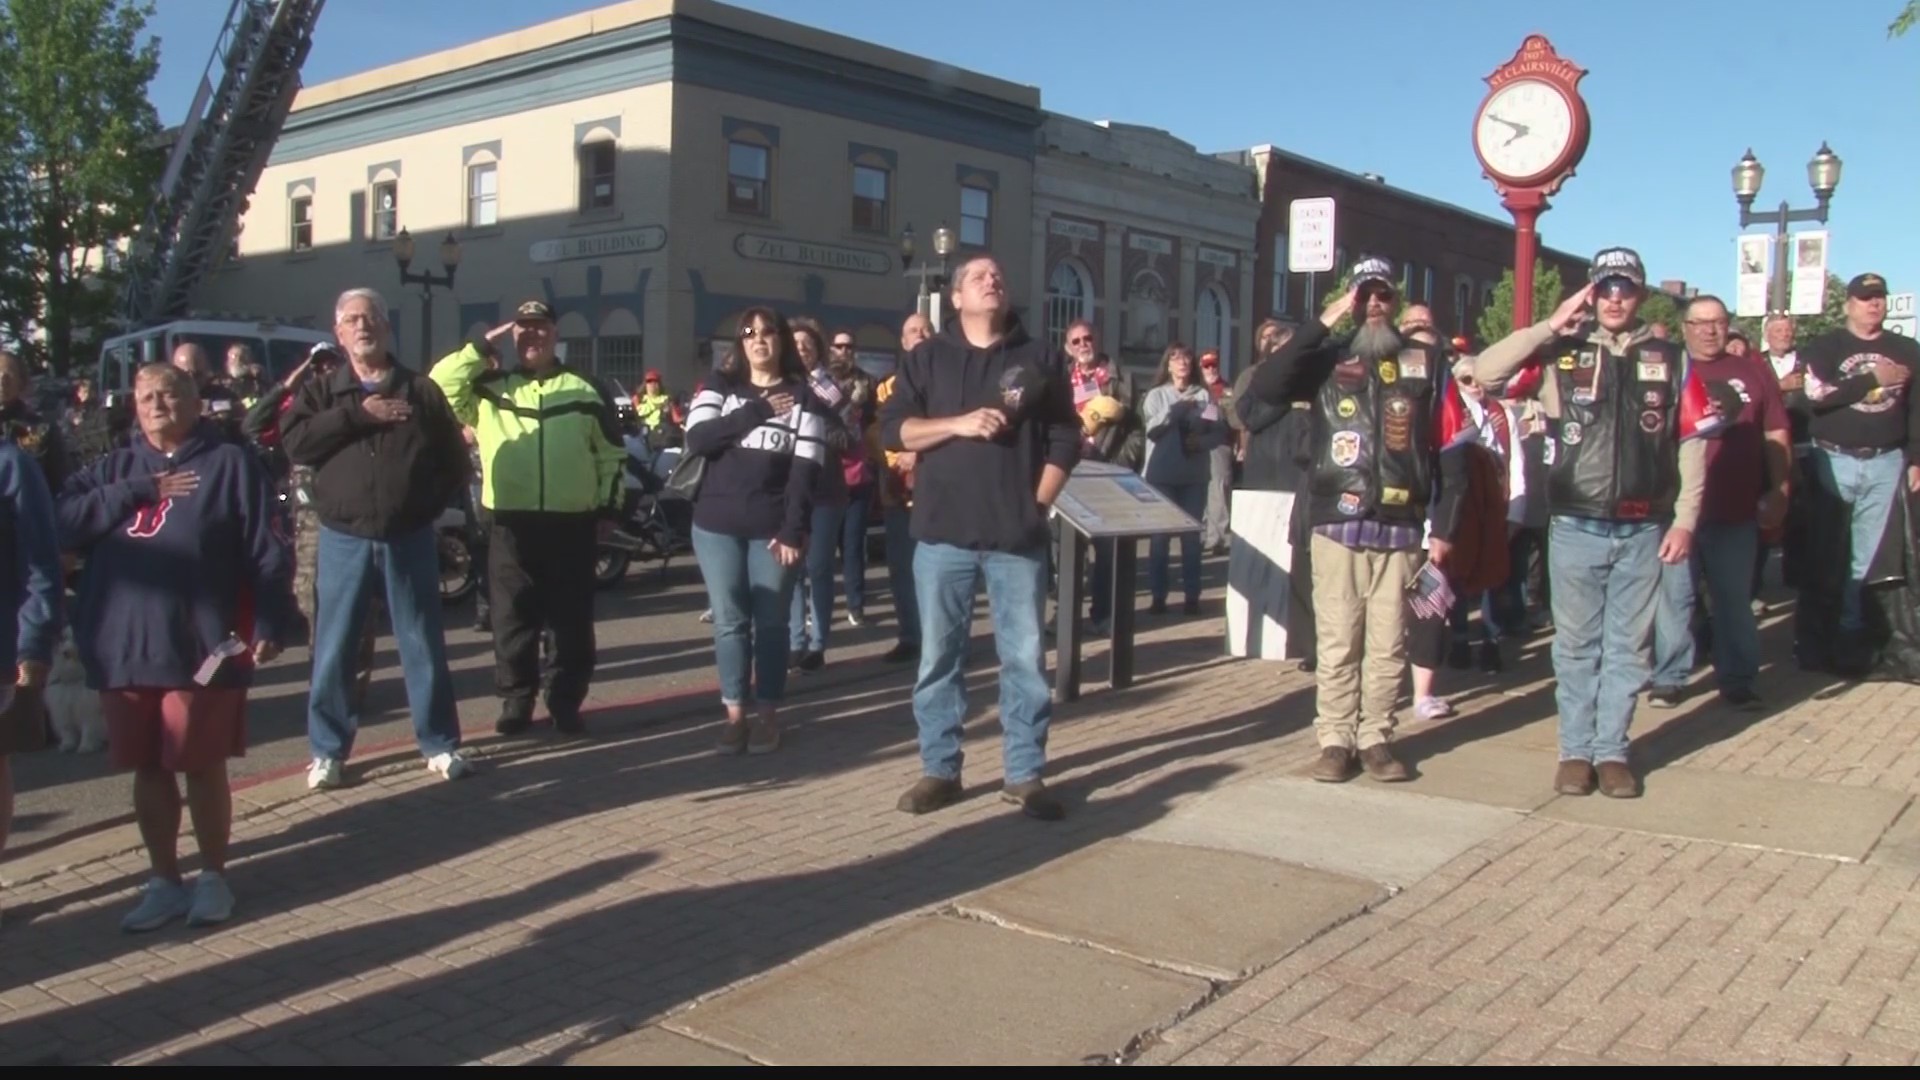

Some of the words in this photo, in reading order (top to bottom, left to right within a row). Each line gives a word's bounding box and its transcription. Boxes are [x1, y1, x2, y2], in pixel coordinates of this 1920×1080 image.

[1504, 61, 1574, 81] CLAIRSVILLE
[577, 234, 646, 255] BUILDING
[798, 246, 872, 268] BUILDING
